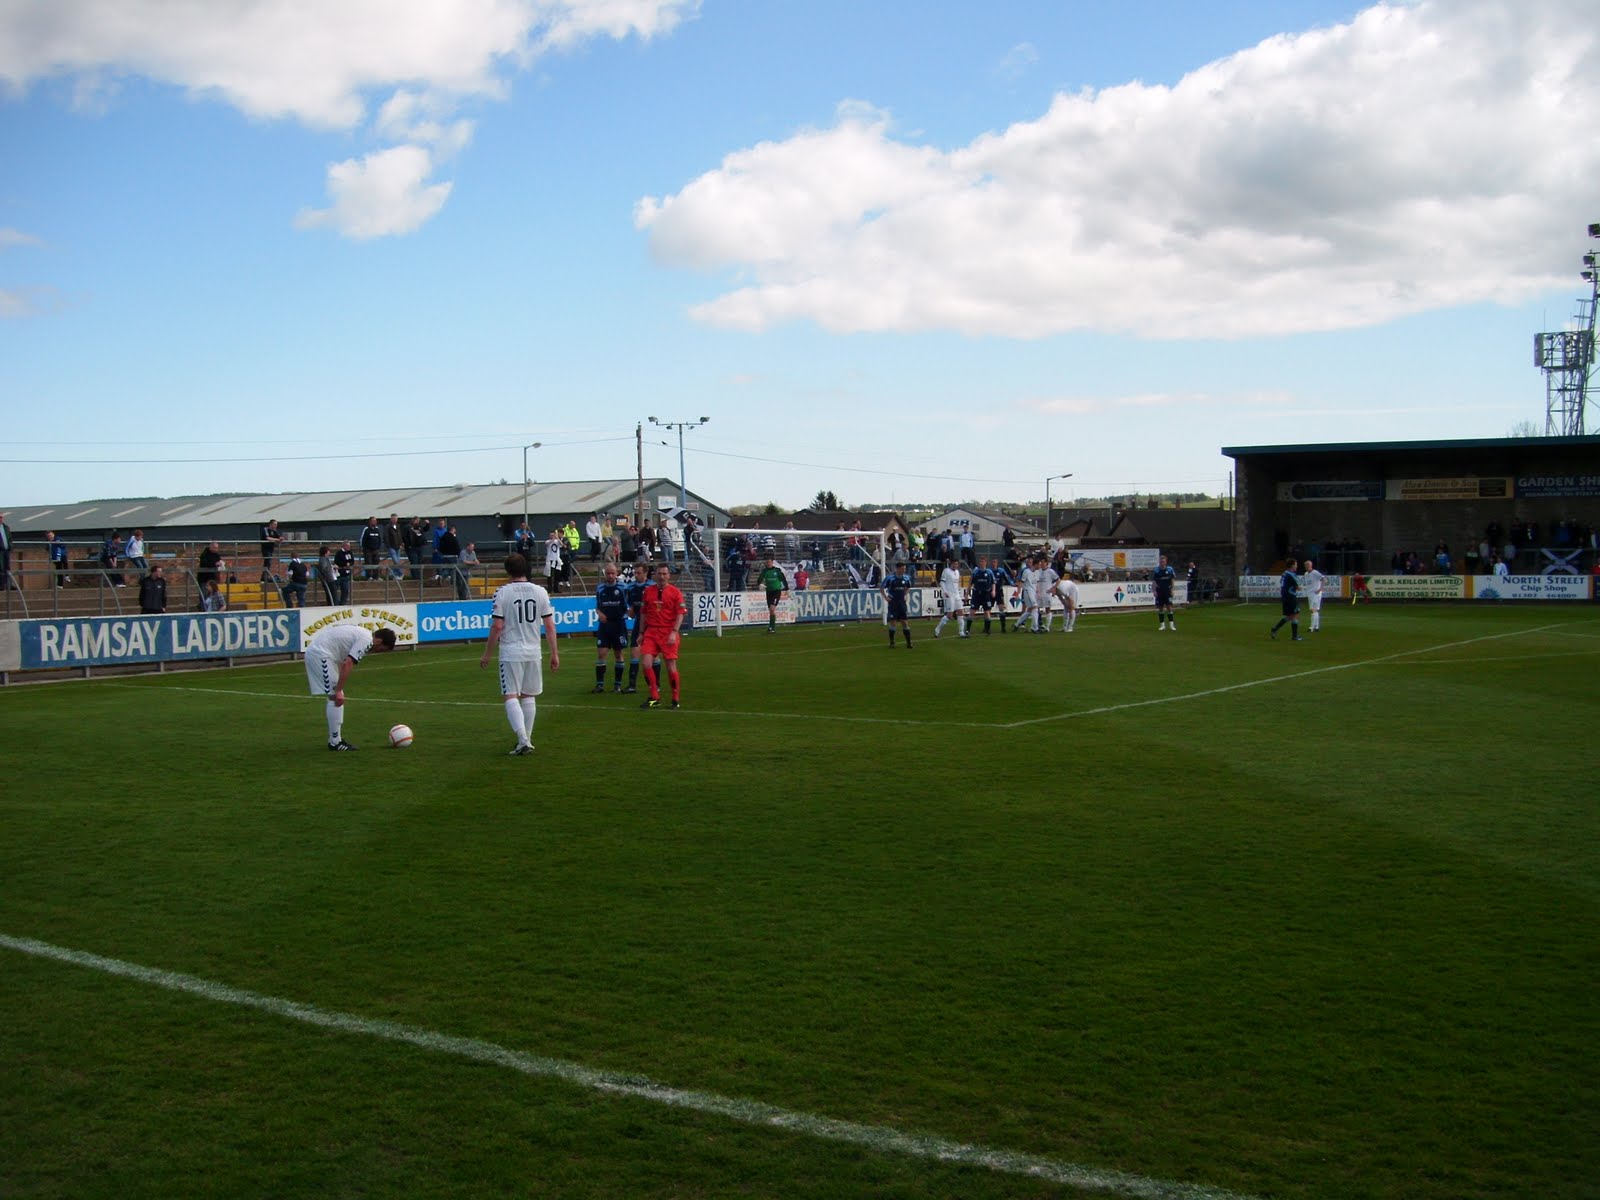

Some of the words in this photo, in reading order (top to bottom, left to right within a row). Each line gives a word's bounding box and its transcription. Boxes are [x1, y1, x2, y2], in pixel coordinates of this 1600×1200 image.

[1518, 476, 1574, 487] GARDEN
[1502, 576, 1541, 585] NORTH
[1547, 576, 1584, 584] STREET
[1544, 584, 1567, 592] Shop
[514, 598, 537, 624] 10
[796, 592, 856, 617] RAMSAY
[857, 591, 920, 615] LADRS
[304, 609, 353, 636] NORTH
[361, 607, 414, 630] STREET
[421, 610, 492, 632] orchar
[39, 620, 161, 662] RAMSAY
[171, 614, 290, 654] LADDERS
